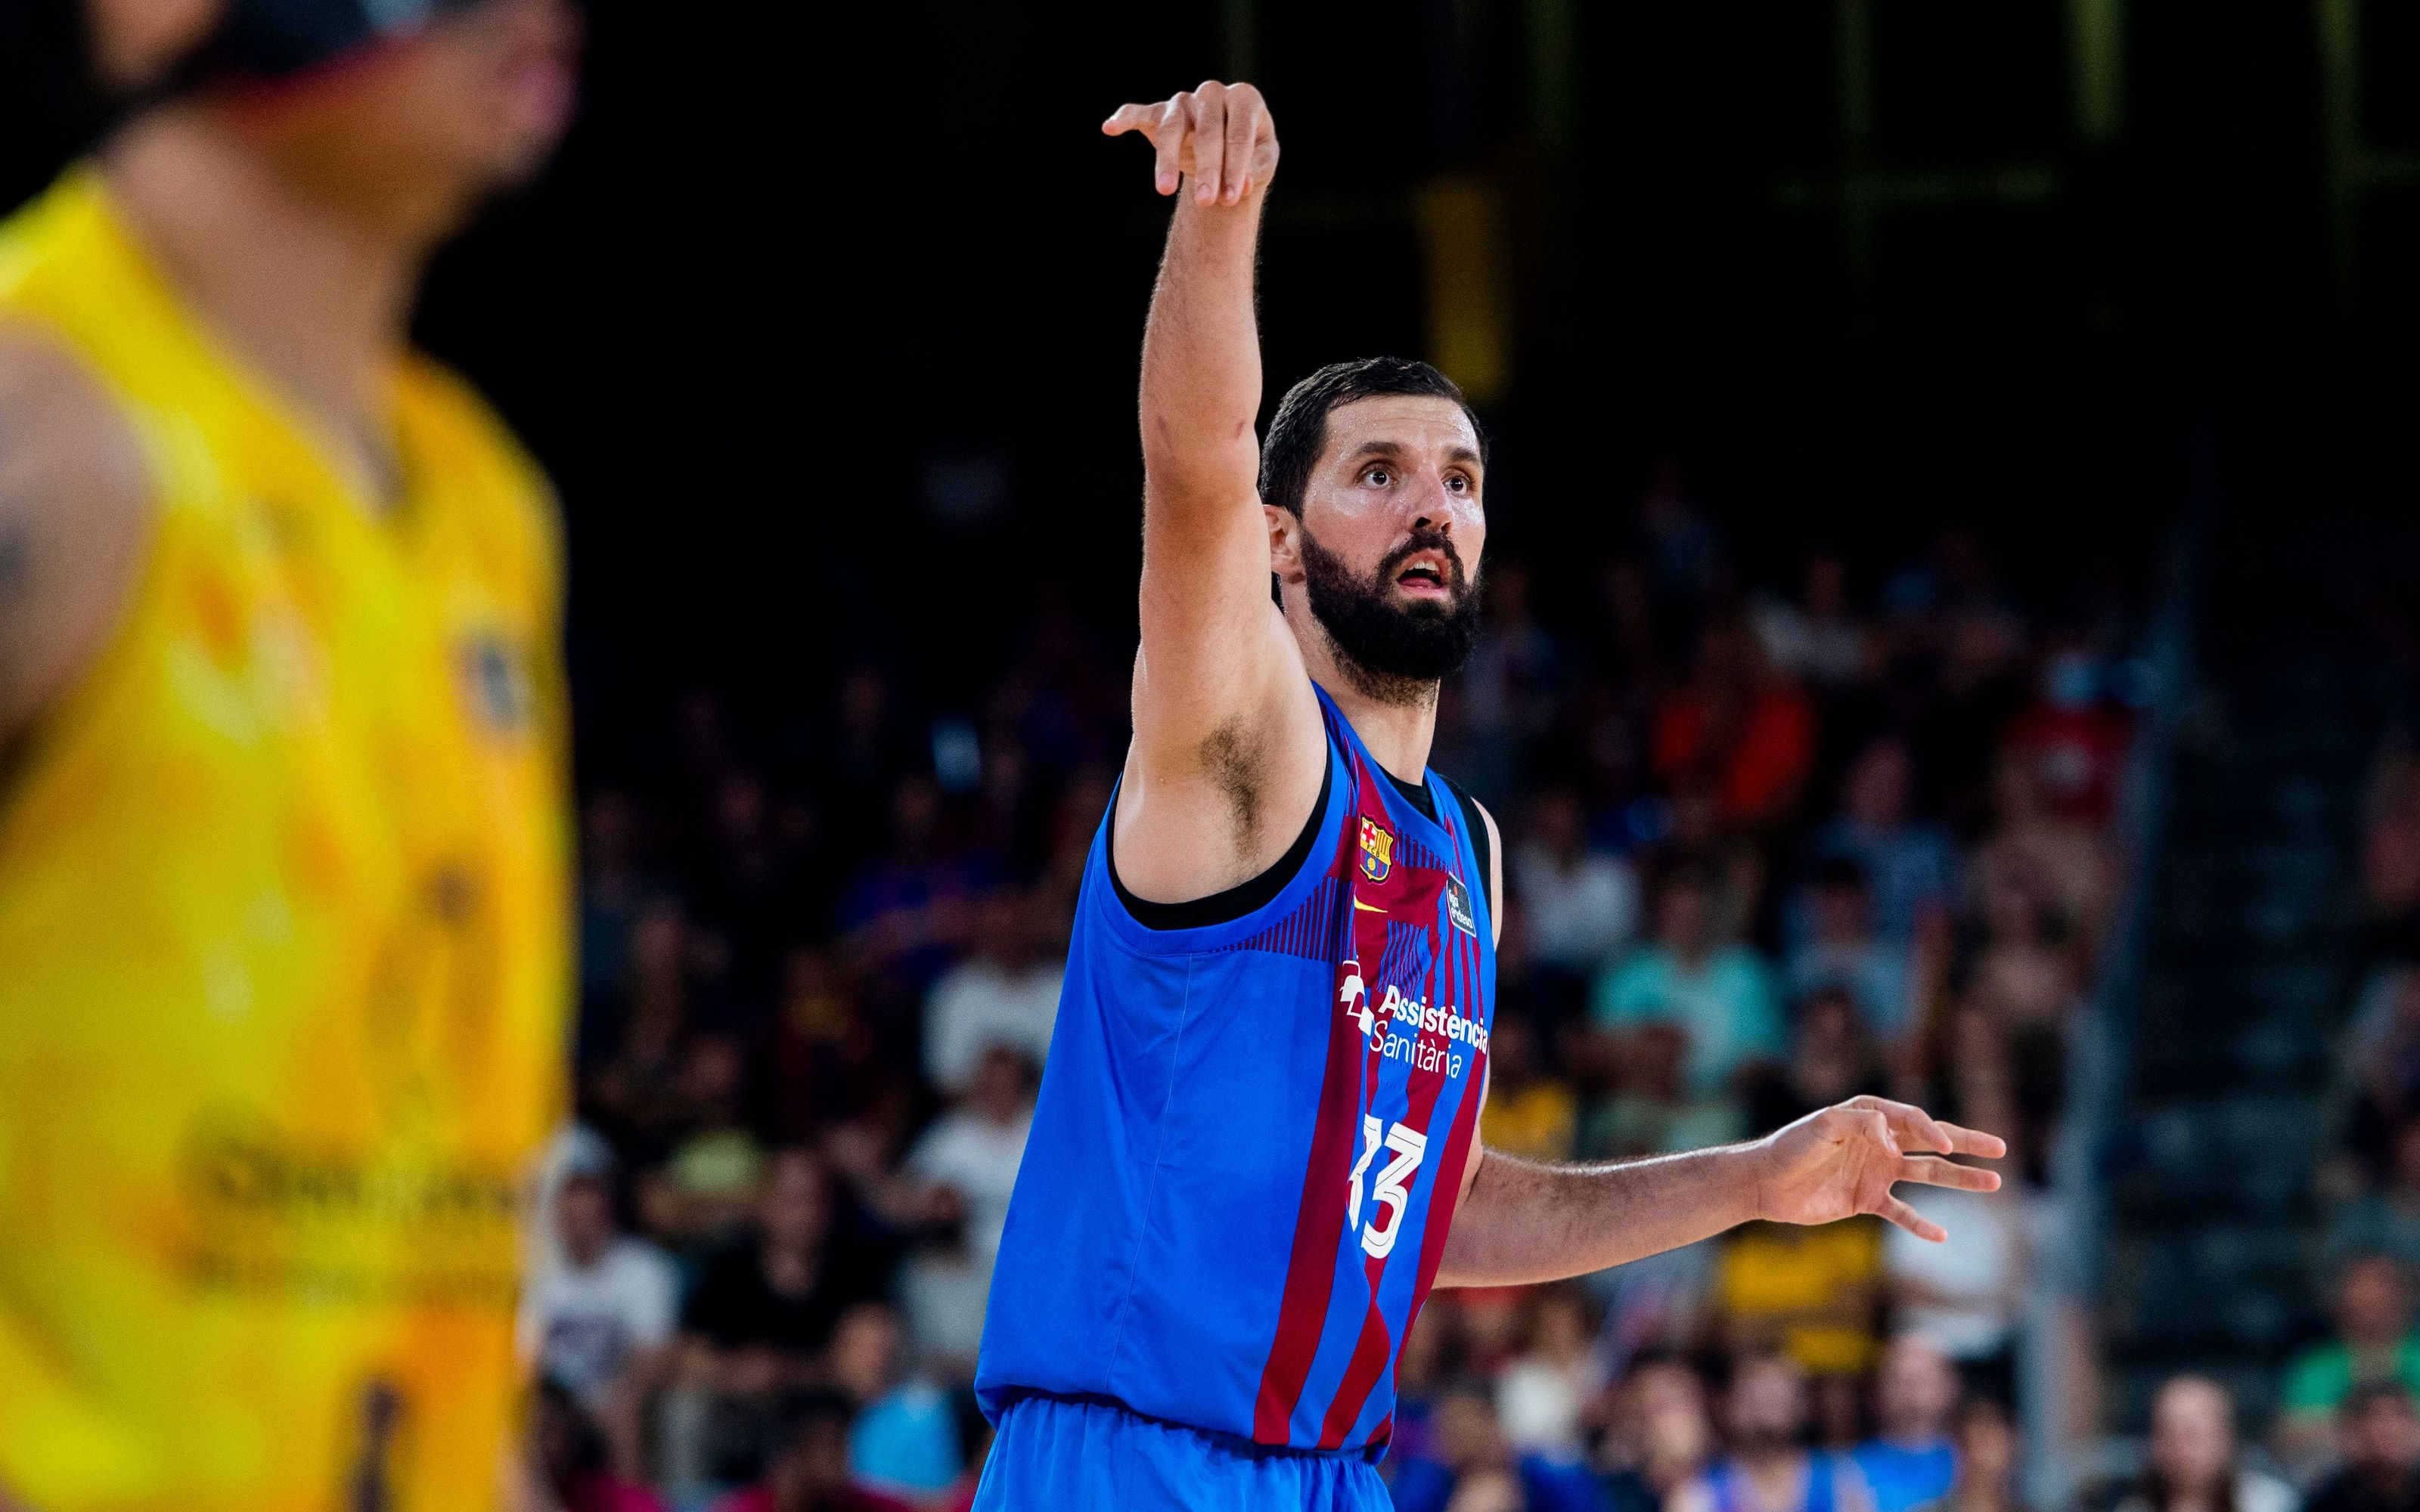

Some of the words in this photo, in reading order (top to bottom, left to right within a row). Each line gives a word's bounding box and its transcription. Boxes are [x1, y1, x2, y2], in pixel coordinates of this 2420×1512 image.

[1451, 906, 1473, 929] endesa
[1378, 984, 1488, 1055] Assistència
[1369, 1020, 1462, 1079] Sanitària
